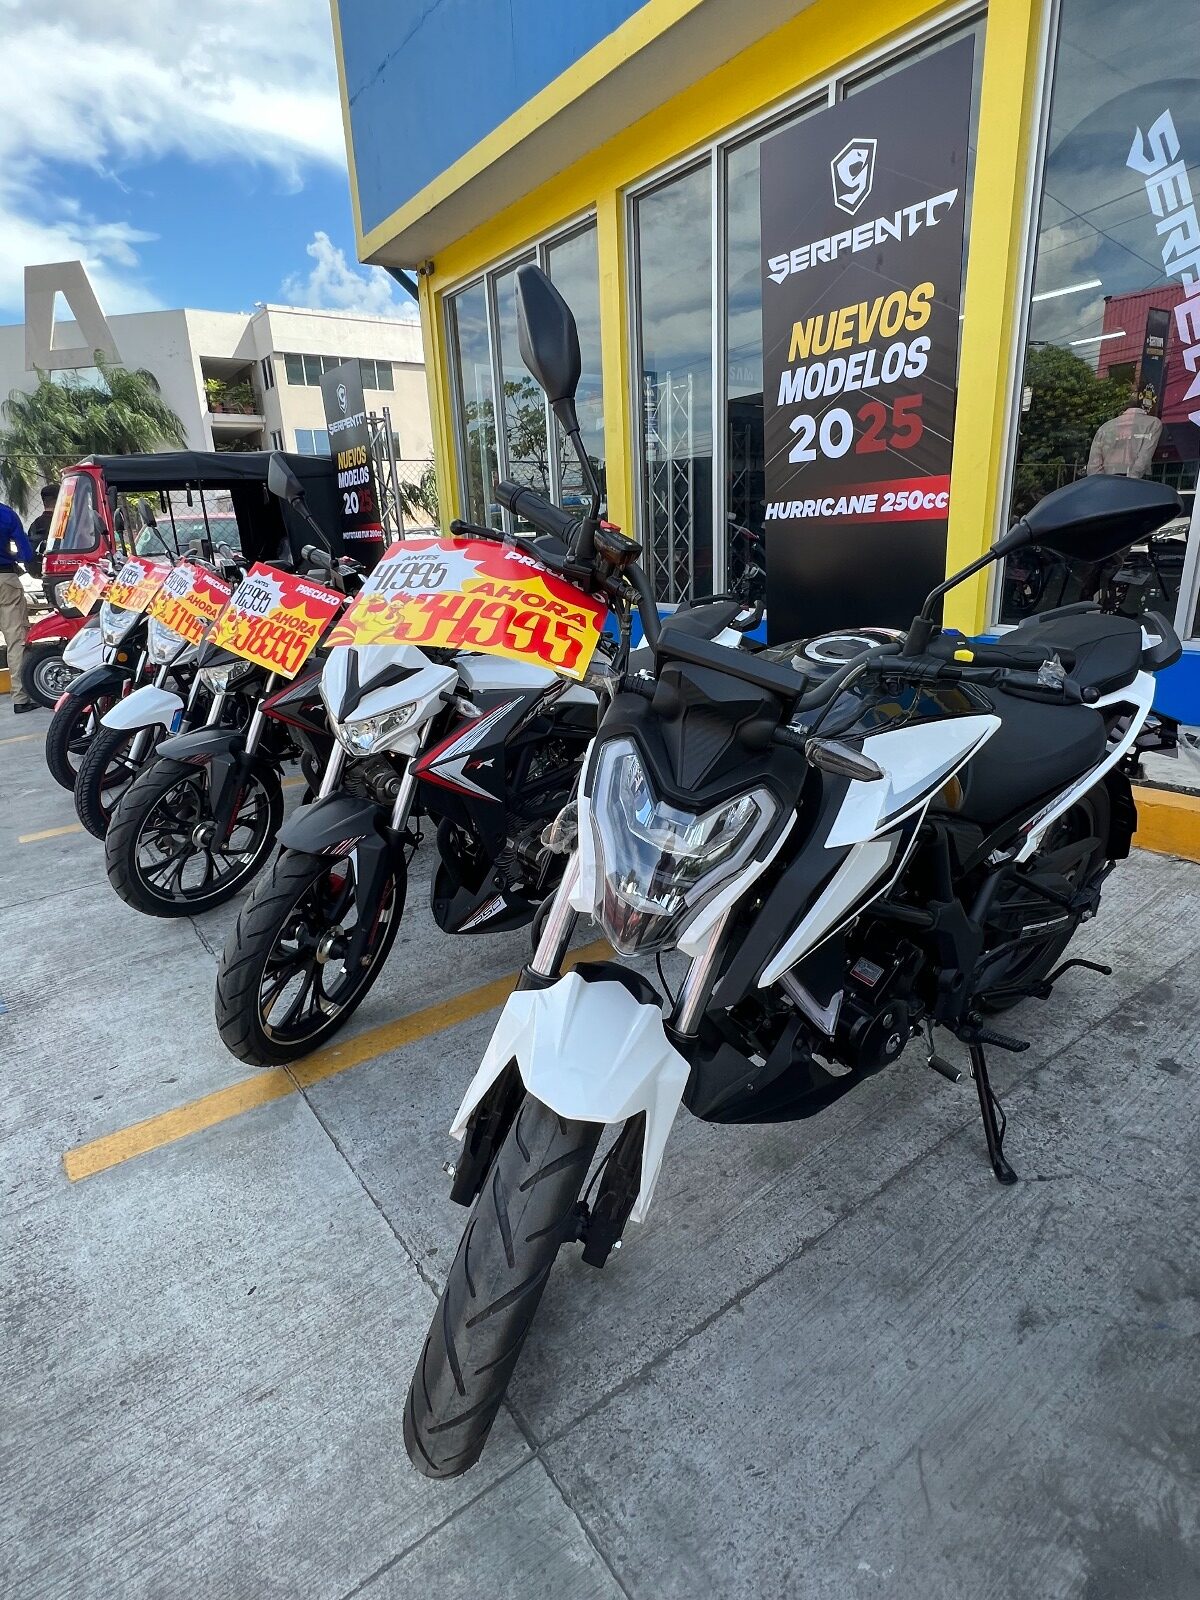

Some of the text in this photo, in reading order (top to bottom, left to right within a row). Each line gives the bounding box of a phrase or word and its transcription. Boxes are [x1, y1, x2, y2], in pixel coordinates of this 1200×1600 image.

[787, 281, 936, 363] NUEVOS
[777, 335, 932, 407] MODELOS
[788, 393, 924, 464] 2025
[337, 445, 367, 470] NUEVOS
[337, 465, 370, 489] MODELOS
[343, 490, 373, 515] 2025
[765, 490, 950, 521] HURRICANE 250cc
[202, 574, 232, 596] PRECIAZO
[295, 583, 340, 606] PRECIAZO
[186, 595, 217, 618] AHORA
[468, 582, 587, 629] AHORA
[270, 611, 318, 637] AHORA
